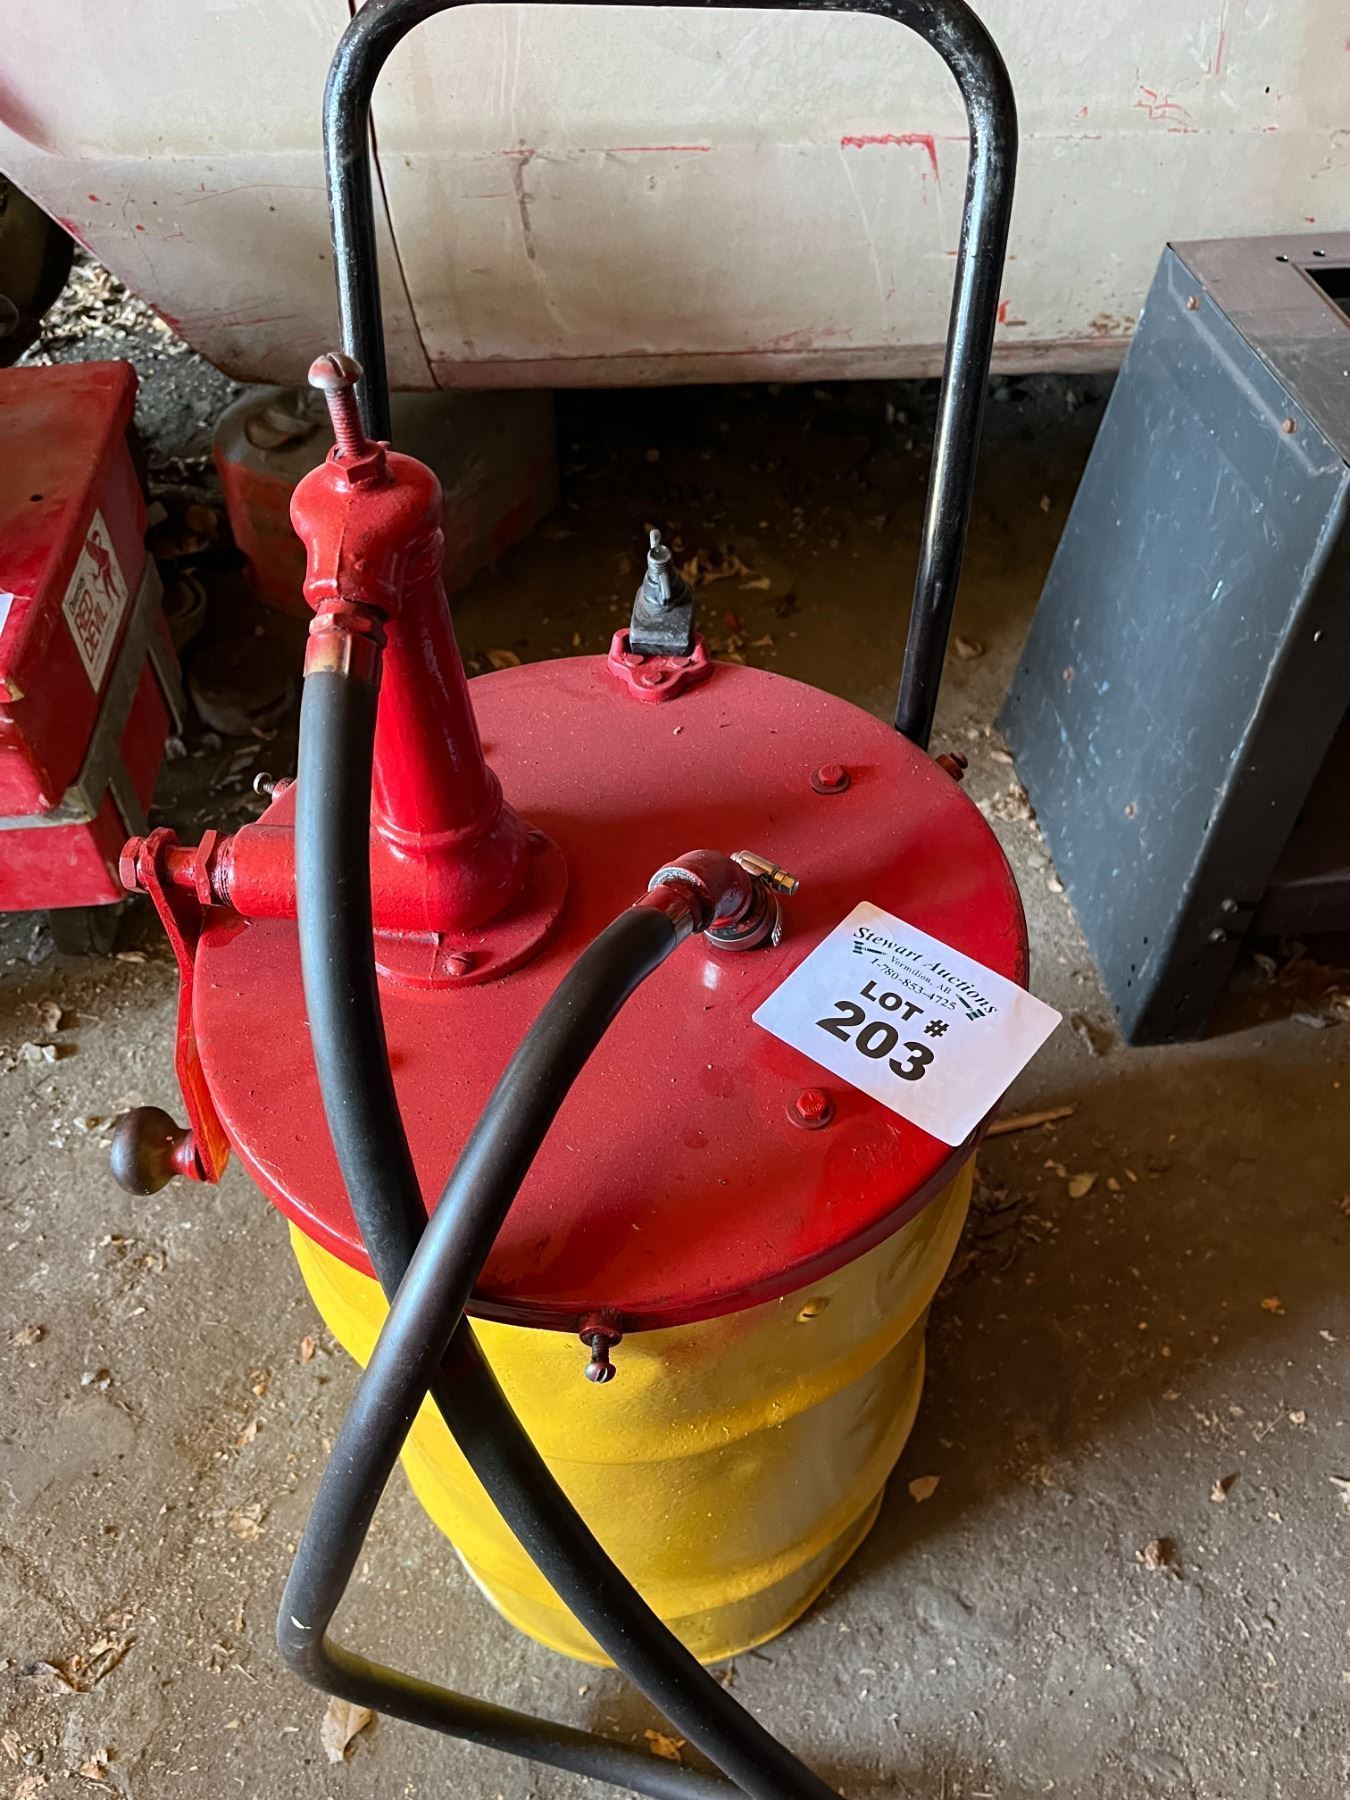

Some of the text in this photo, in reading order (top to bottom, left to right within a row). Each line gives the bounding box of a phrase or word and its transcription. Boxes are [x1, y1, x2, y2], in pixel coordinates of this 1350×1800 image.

[74, 589, 94, 642] RED
[84, 602, 108, 664] DEVIL
[853, 927, 998, 1013] Stewart Auctions
[870, 958, 957, 1010] 1-780-853-4725
[891, 956, 952, 994] Vermilion, AB
[860, 980, 950, 1038] LOT #
[815, 1000, 935, 1081] 203
